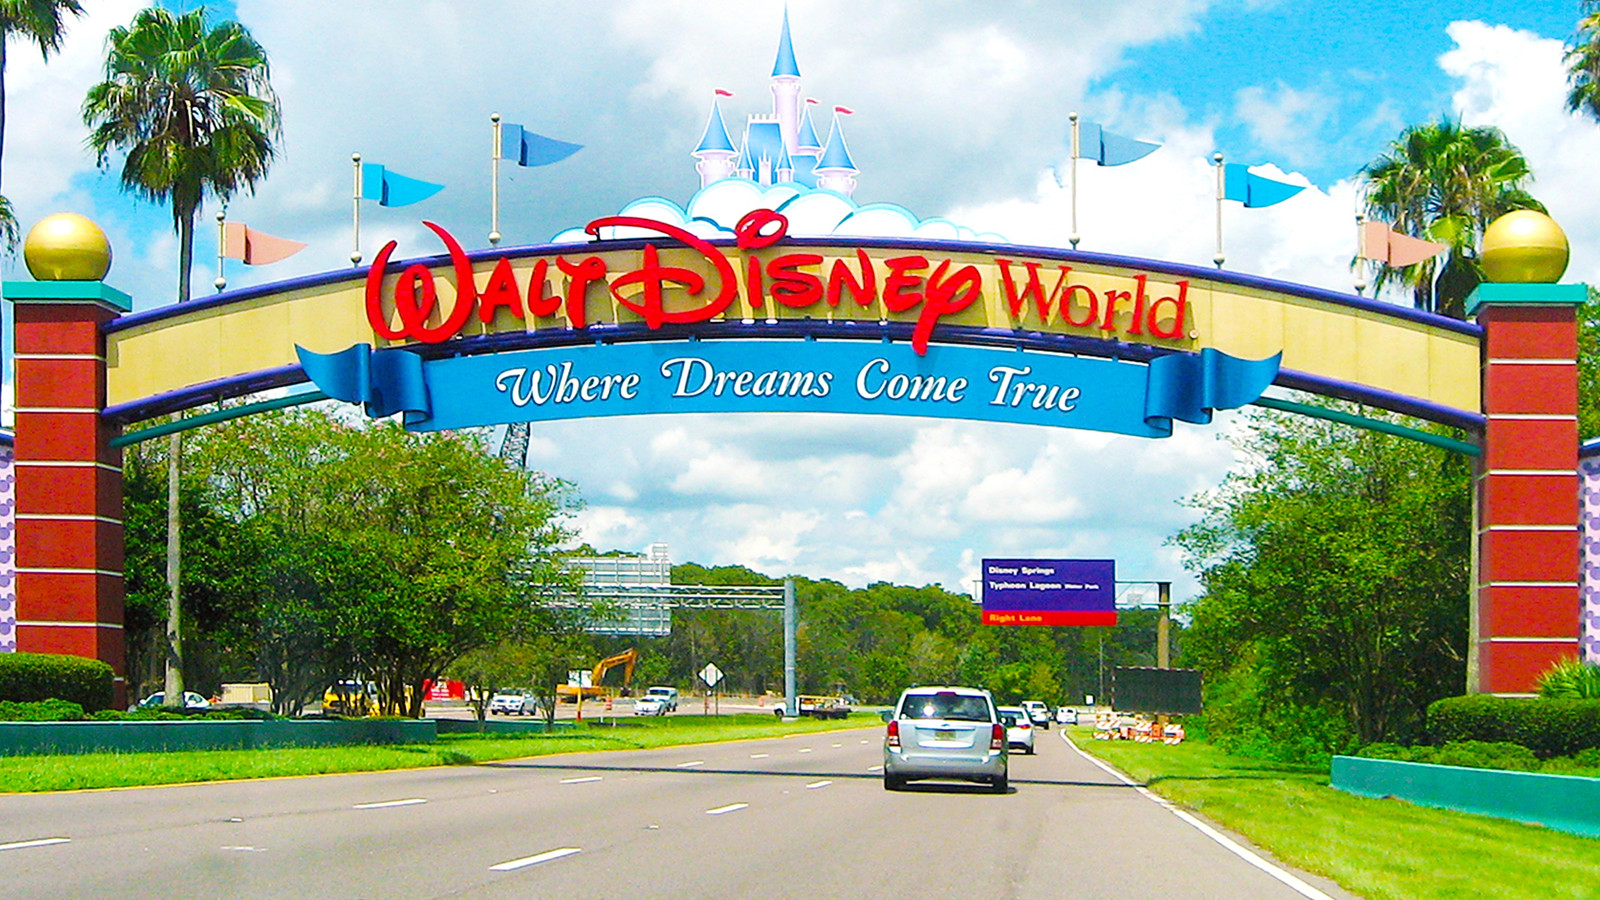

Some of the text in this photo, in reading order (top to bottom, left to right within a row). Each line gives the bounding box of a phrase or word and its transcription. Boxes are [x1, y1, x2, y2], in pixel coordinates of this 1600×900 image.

[995, 259, 1189, 340] World
[496, 356, 1081, 412] Where Dreams Come True
[988, 566, 1055, 576] Disney Springs
[989, 581, 1027, 590] Typhoon
[1029, 581, 1062, 591] Lagoon
[988, 613, 1043, 623] Right Lane
